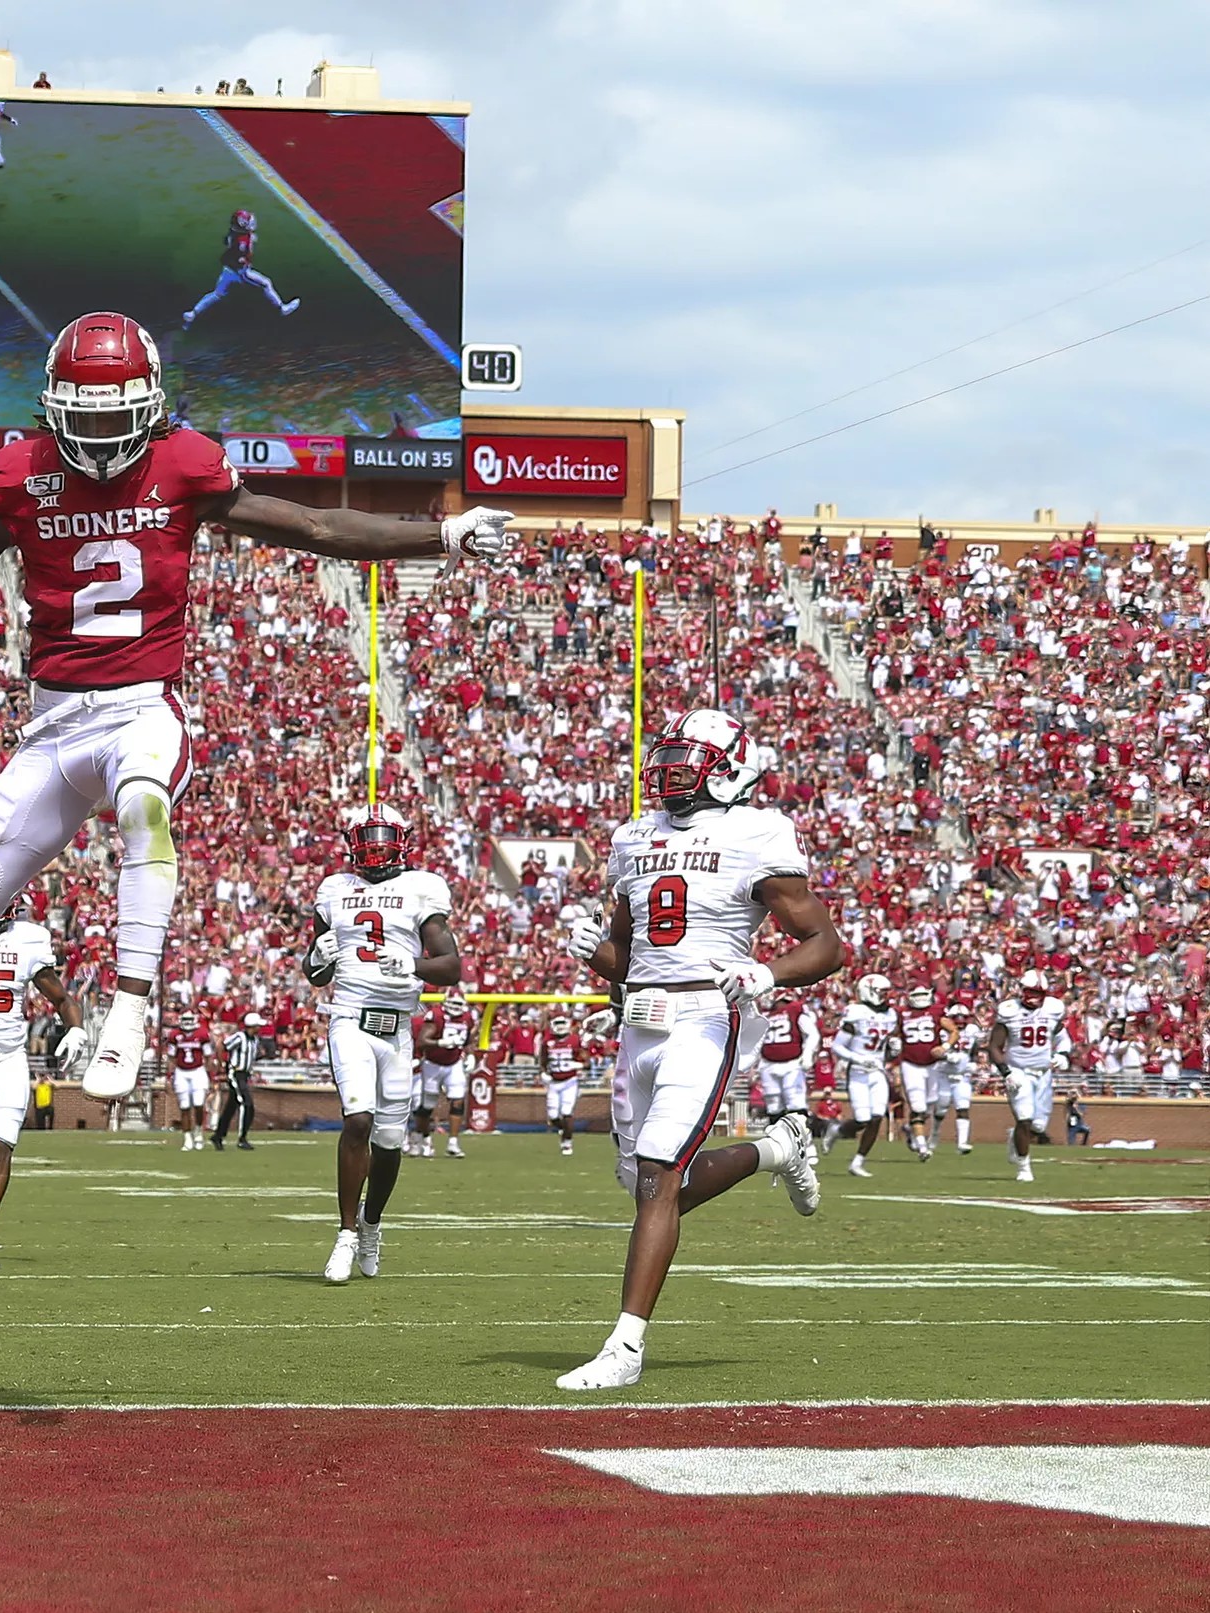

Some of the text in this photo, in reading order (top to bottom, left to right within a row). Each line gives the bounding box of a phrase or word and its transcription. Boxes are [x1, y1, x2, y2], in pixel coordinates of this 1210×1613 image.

[472, 353, 511, 382] 40
[240, 440, 269, 464] 10
[353, 449, 454, 468] BALL ON 35
[473, 445, 620, 485] OU Medicine
[36, 507, 172, 540] SOONERS
[70, 538, 145, 638] 2
[634, 851, 721, 876] TEXAS TECH
[342, 896, 404, 910] TEXAS TECH
[647, 874, 689, 948] 8
[354, 910, 386, 963] 3
[1020, 1025, 1048, 1049] 96
